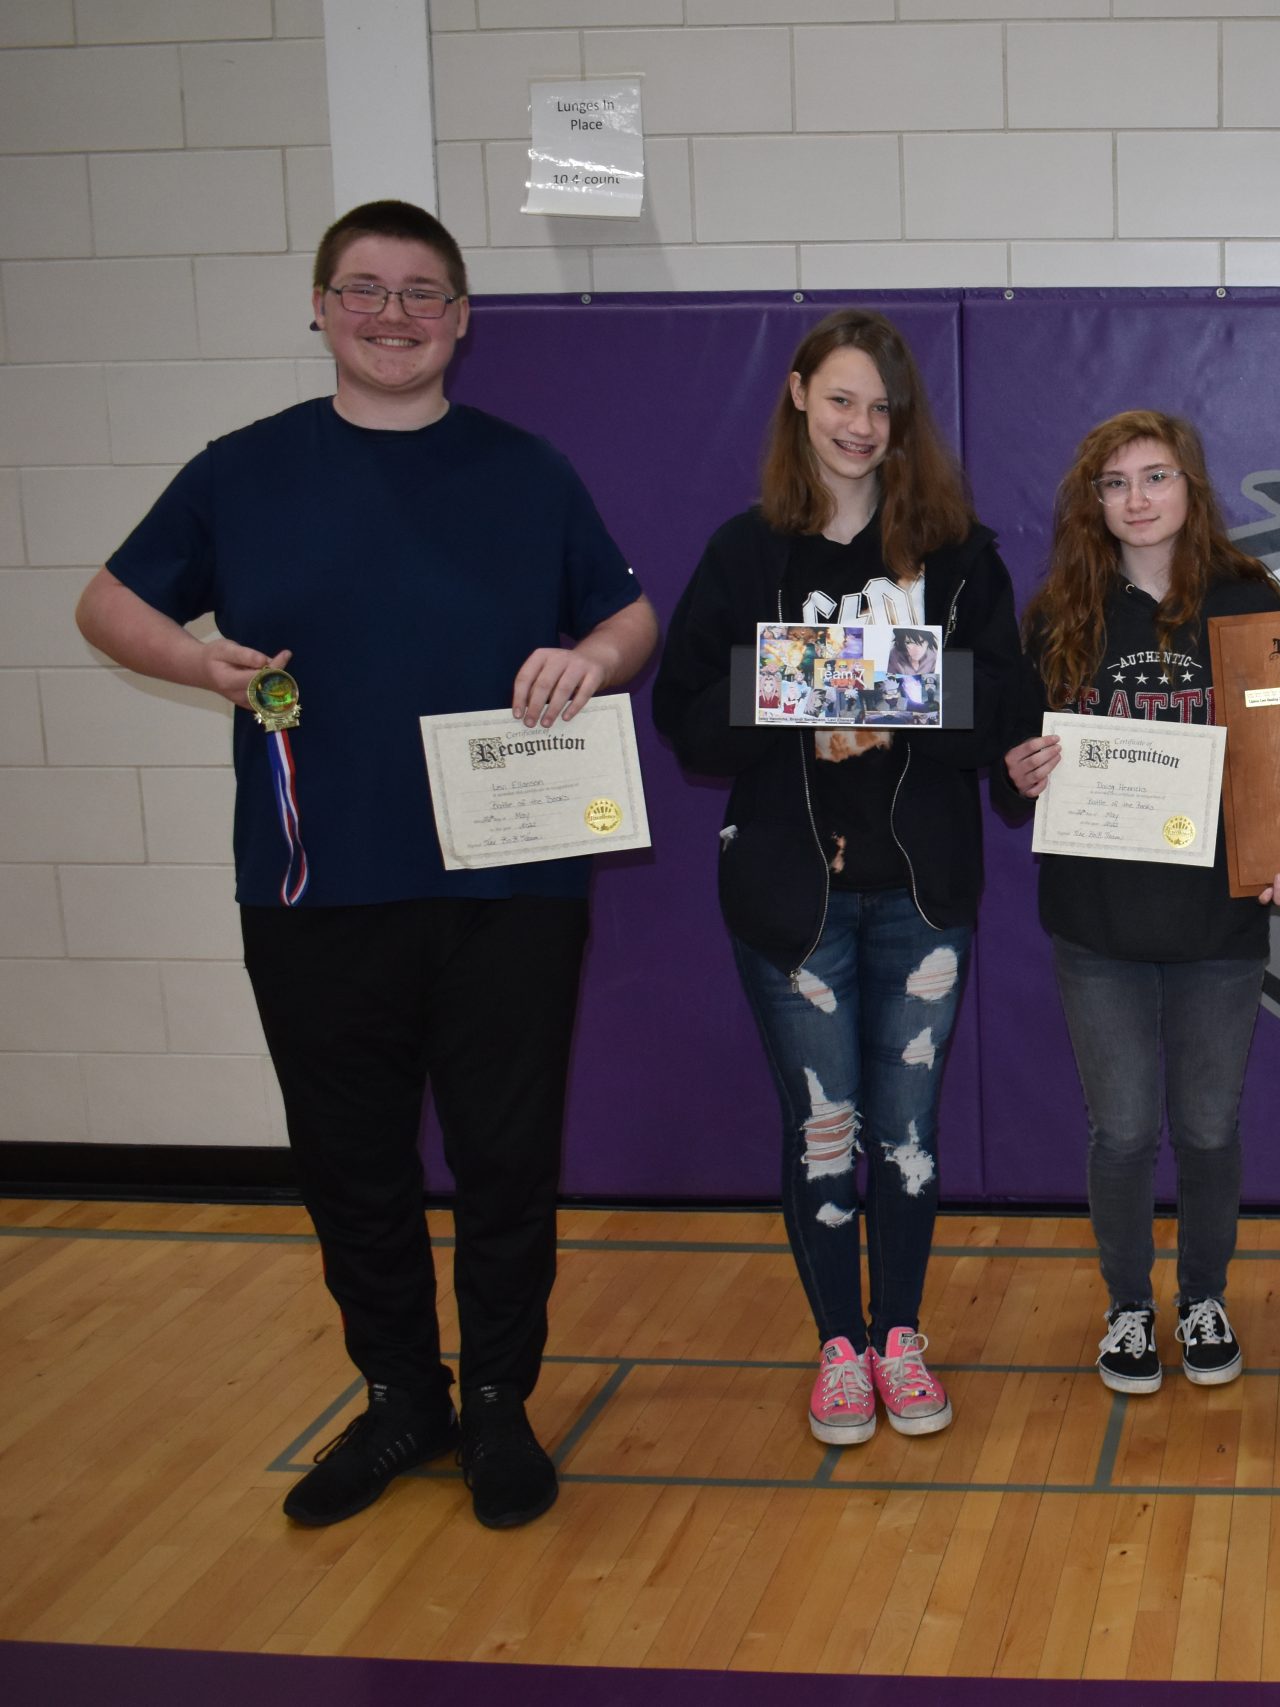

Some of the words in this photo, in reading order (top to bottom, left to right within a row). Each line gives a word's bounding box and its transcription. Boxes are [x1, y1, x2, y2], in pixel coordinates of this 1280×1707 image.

[557, 101, 599, 114] Lunges
[570, 119, 603, 131] Place
[553, 173, 568, 185] 10
[584, 173, 620, 185] count
[1119, 650, 1192, 668] AUTHENTIC
[817, 667, 852, 680] Team
[505, 729, 542, 740] Certificate
[476, 733, 585, 764] Recognition
[1114, 737, 1146, 747] Certificate
[1085, 743, 1180, 769] Recognition
